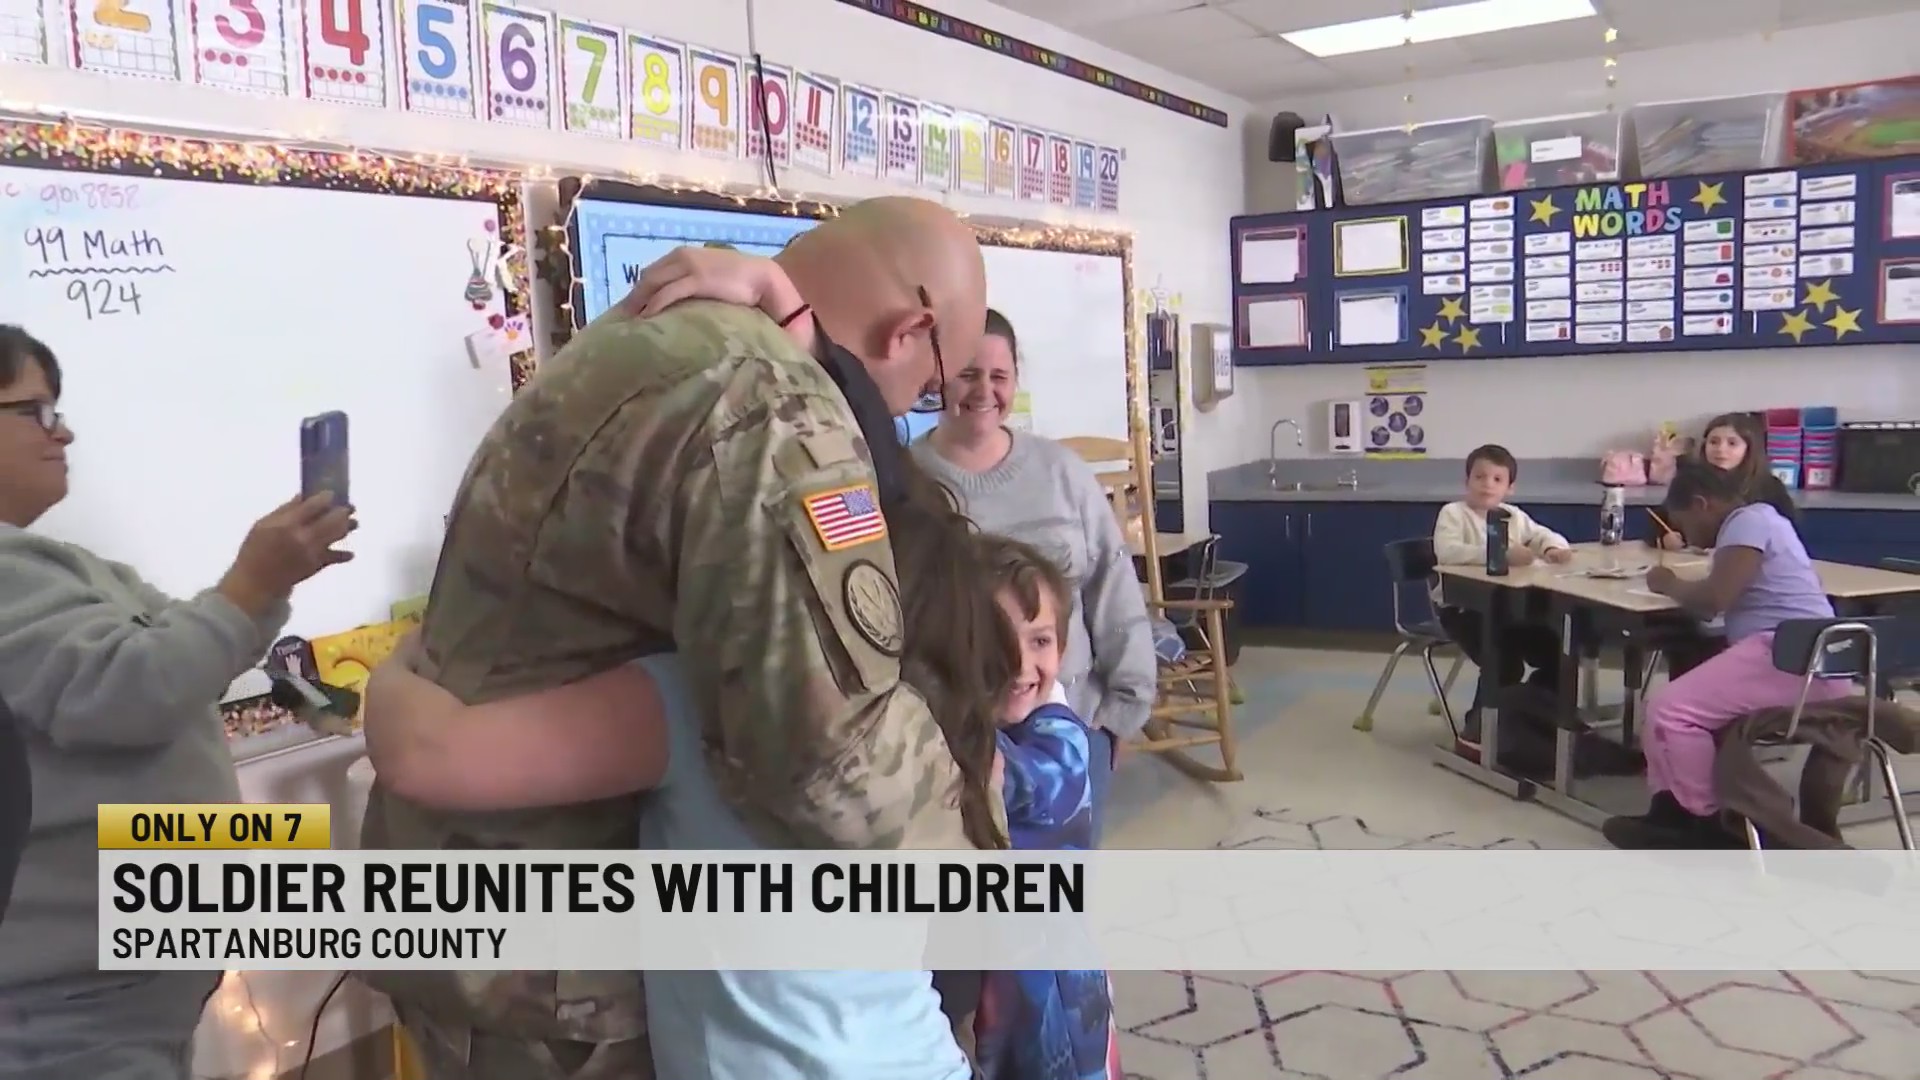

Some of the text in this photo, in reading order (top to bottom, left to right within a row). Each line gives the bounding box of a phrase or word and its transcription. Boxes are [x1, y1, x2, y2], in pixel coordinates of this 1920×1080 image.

[215, 0, 266, 48] 3
[321, 0, 370, 66] 4
[417, 4, 457, 79] 5
[501, 22, 536, 92] 6
[577, 35, 607, 104] 7
[642, 53, 671, 115] 8
[700, 65, 728, 126] 9
[750, 74, 787, 136] 10
[807, 86, 822, 127] 11
[851, 95, 873, 136] 12
[893, 104, 912, 142] 13
[928, 118, 948, 151] 14
[994, 128, 1010, 162] 16
[1027, 136, 1041, 168] 17
[1054, 142, 1068, 173] 18
[1078, 147, 1093, 178] 19
[1100, 153, 1118, 182] 20
[1574, 181, 1670, 212] MATH
[1573, 207, 1682, 238] WORDS
[24, 226, 164, 264] 99 Math
[67, 279, 141, 320] 924
